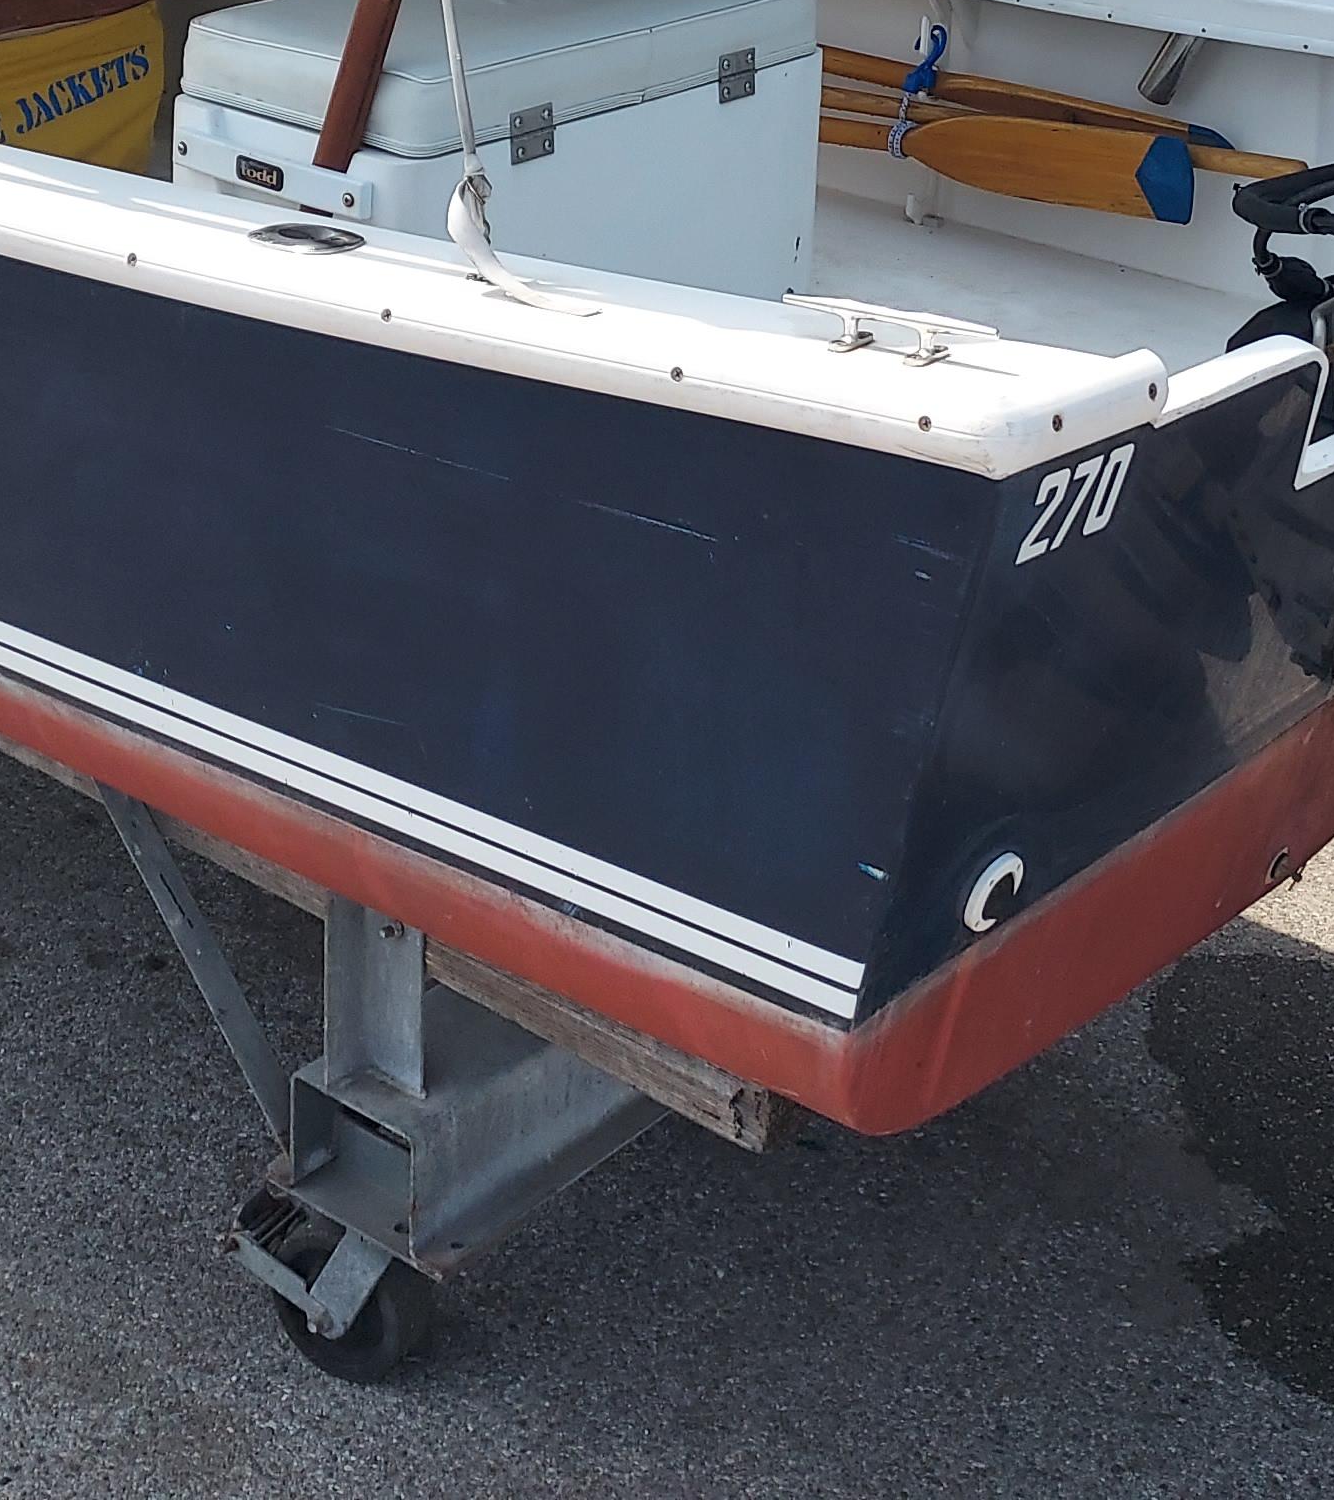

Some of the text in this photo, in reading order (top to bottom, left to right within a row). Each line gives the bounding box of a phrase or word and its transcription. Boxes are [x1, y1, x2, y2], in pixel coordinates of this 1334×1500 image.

[15, 44, 150, 134] JACKETS
[240, 159, 278, 187] todd
[1014, 442, 1135, 566] 270
